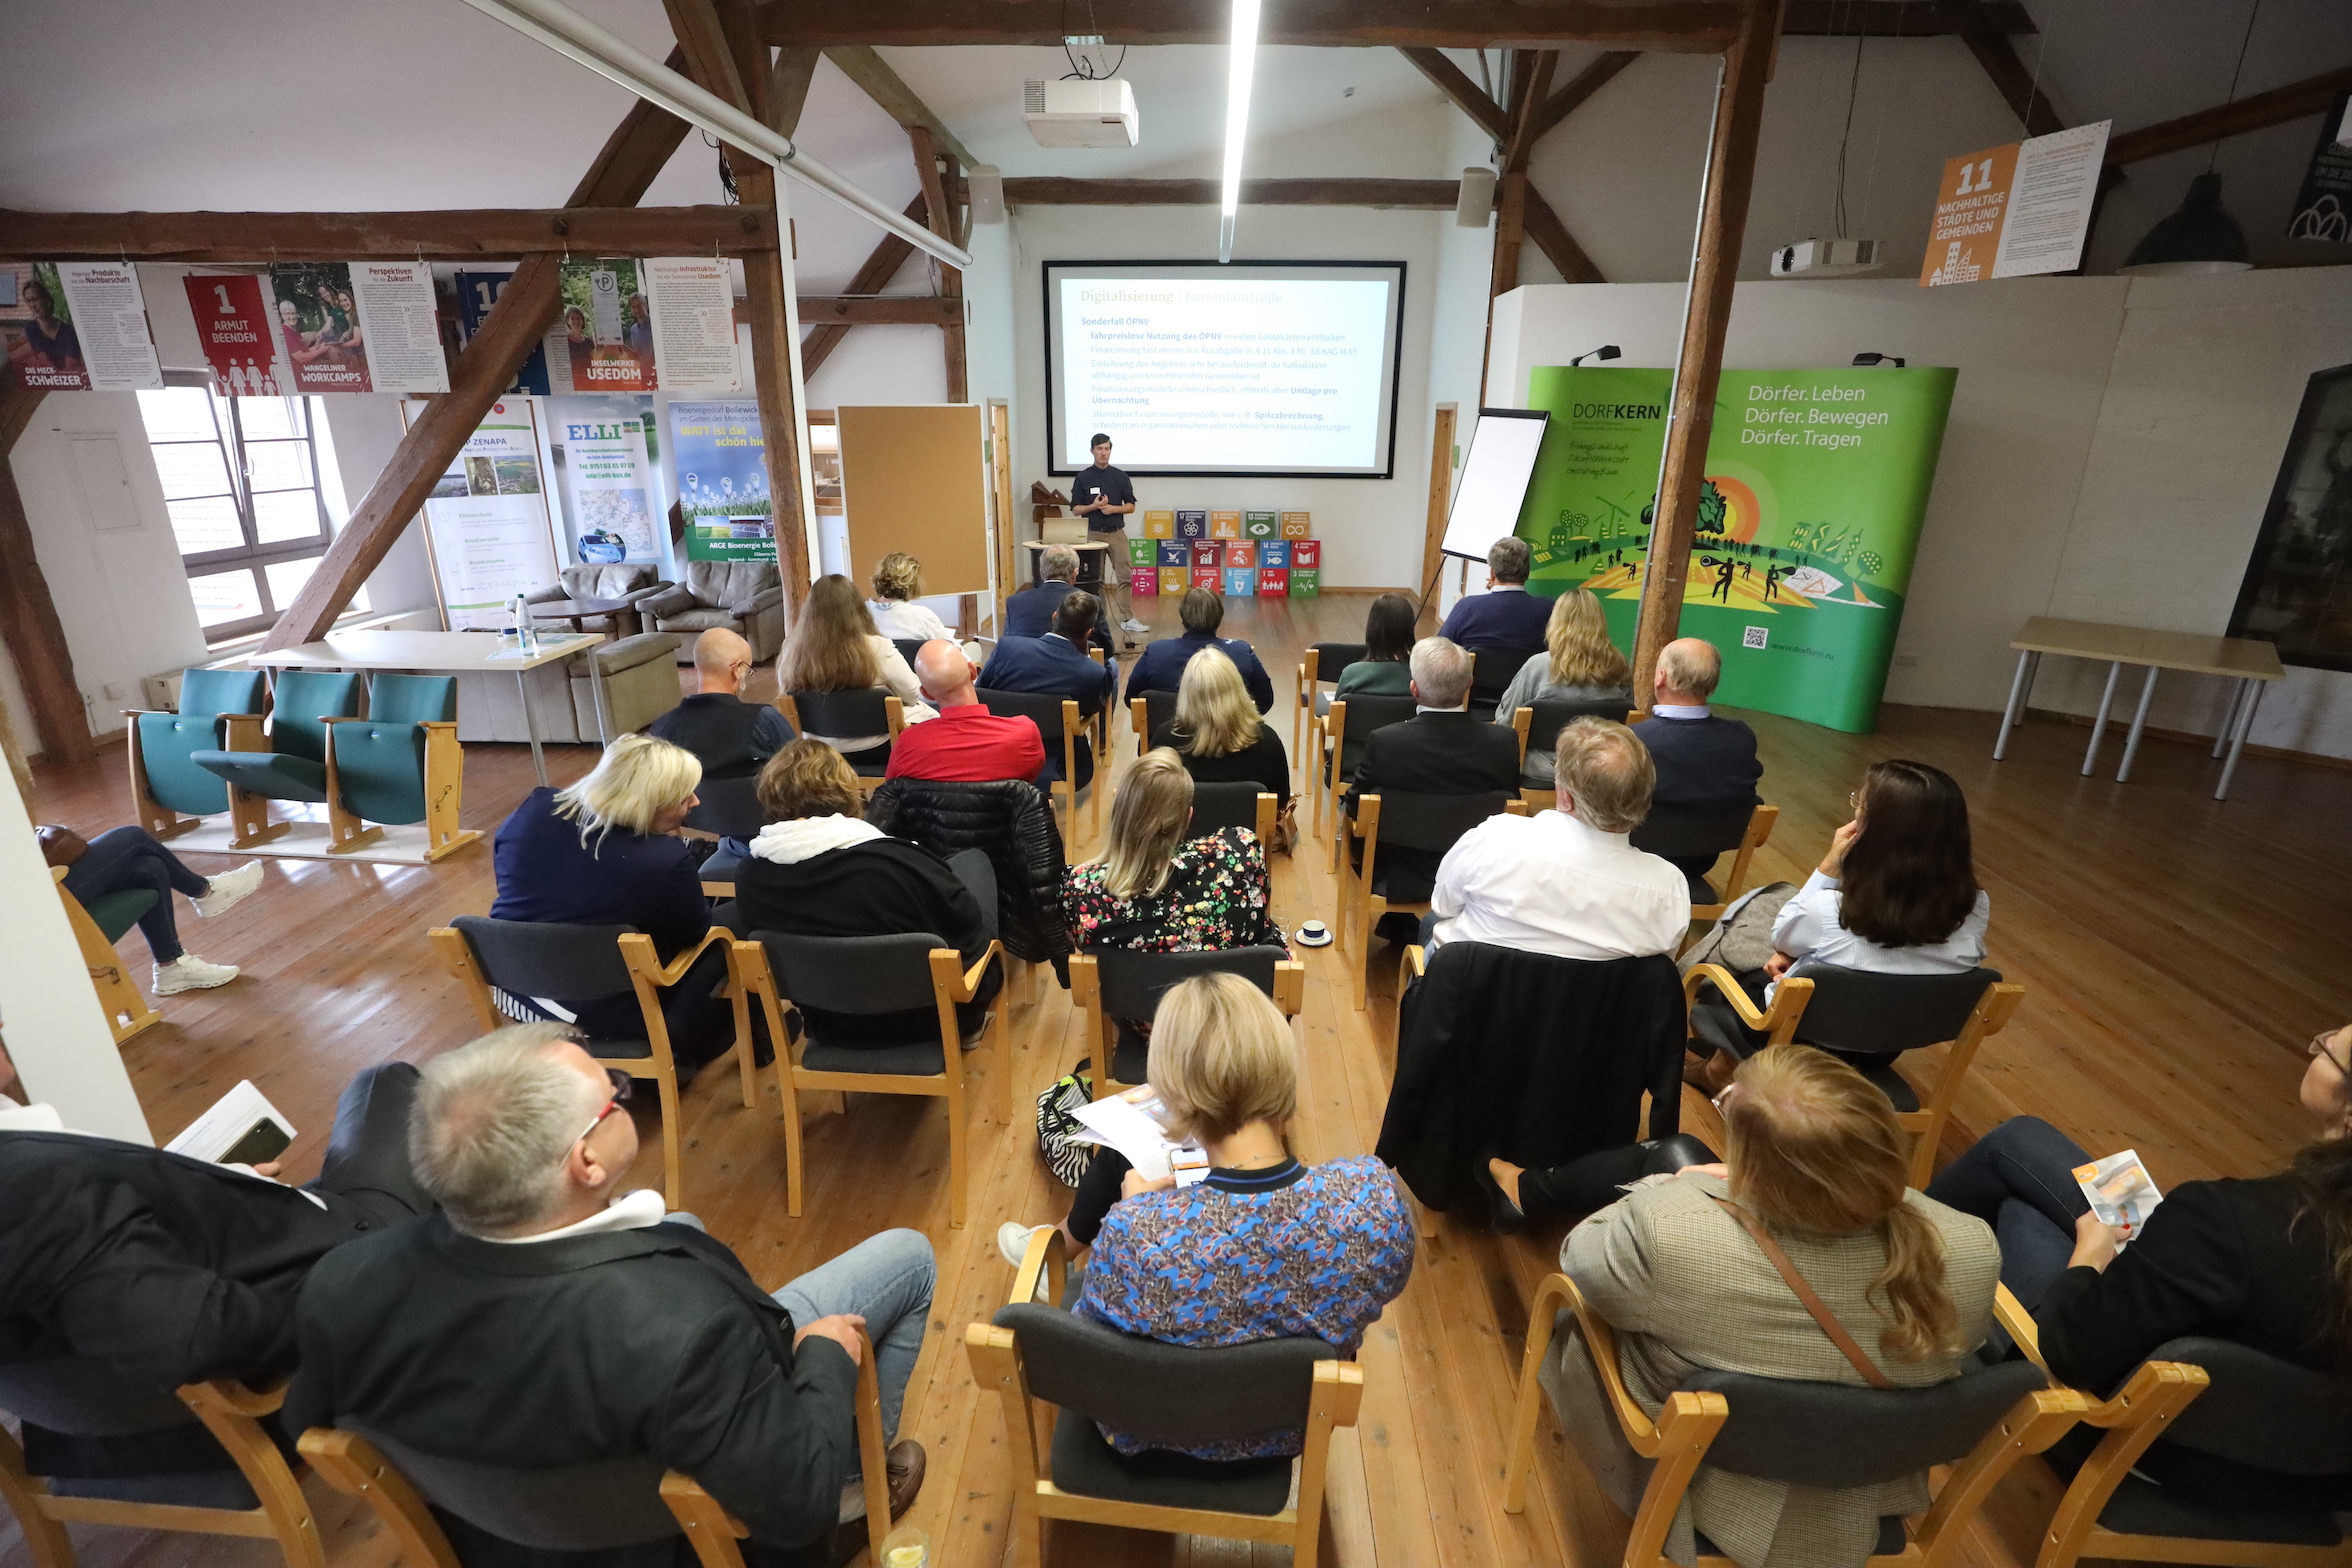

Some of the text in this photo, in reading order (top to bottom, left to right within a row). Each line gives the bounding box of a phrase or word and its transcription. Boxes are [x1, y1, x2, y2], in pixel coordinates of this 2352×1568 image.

[1956, 158, 1993, 196] 11
[1938, 191, 2005, 215] NACHHALTIGE
[1936, 206, 1999, 229] STÄDTE UND
[1936, 221, 1994, 241] GEMEINDEN
[91, 269, 121, 277] Produkte
[369, 267, 413, 277] Perspektiven
[85, 276, 131, 284] Nachbarschaft
[387, 274, 414, 283] Zukunft
[213, 284, 237, 314] 1
[1080, 289, 1283, 305] Digitalisierung Kartenkontrolle
[214, 320, 249, 332] ARMUT
[1081, 315, 1150, 326] Sonderfall ÖPNV
[211, 332, 258, 343] BEENDEN
[1090, 331, 1145, 341] fahrpreislose
[1146, 332, 1181, 342] Nutzung
[1183, 331, 1197, 340] des
[1198, 330, 1223, 340] ÖPNV
[1233, 332, 1256, 341] vielen
[1307, 333, 1346, 342] enthalten
[1090, 345, 1142, 355] Finanzierung
[1142, 345, 1157, 354] fast
[1159, 346, 1184, 354] immer
[1201, 346, 1244, 356] Kurabgabe
[1272, 347, 1288, 355] Abs.
[1310, 347, 1320, 355] 1d
[1321, 347, 1338, 356] KAG
[1339, 347, 1357, 357] M-V)
[303, 364, 347, 372] WANGELINER
[590, 359, 635, 368] INSELWERKE
[1135, 359, 1149, 368] des
[1150, 360, 1187, 370] Angebots
[1188, 360, 1205, 368] sehr
[1271, 360, 1281, 369] da
[1282, 361, 1327, 370] Kalkulation
[24, 366, 57, 375] DIE MECK-
[586, 367, 642, 381] USEDOM
[1129, 372, 1144, 380] von
[1145, 371, 1203, 380] teilnehmenden
[1204, 371, 1250, 380] Gemeinden
[1251, 372, 1261, 380] ist
[25, 374, 83, 386] SCHWEIZER
[301, 372, 362, 383] WORKCAMPS
[1091, 385, 1177, 395] Finanzierungsmodelle
[1240, 385, 1270, 394] oftmals
[1271, 386, 1289, 394] aber
[1290, 386, 1322, 396] Umlage
[1323, 388, 1338, 396] pro
[1748, 384, 1866, 402] Dörfer. Leben
[1092, 395, 1150, 406] Übernachtung
[677, 405, 758, 415] Bioenergiedorf Bollewick
[1092, 410, 1133, 418] alternative
[1134, 410, 1221, 420] Finanzierungsmodelle,
[1222, 411, 1236, 419] wie
[1573, 403, 1661, 420] DORFKERN
[688, 415, 711, 423] Garten
[711, 415, 723, 423] der
[1745, 407, 1889, 430] Dörfer. Bewegen
[566, 424, 622, 441] ELLI
[680, 425, 747, 436] WATT ist dat
[1092, 421, 1351, 433] scheitern an organisatorischen oder technischen Herausforderungen
[473, 437, 507, 446] ZENAPA
[714, 436, 747, 447] schön
[1740, 428, 1862, 450] Dörfer. Tragen
[458, 511, 493, 519] Klimaschutz
[727, 541, 761, 550] Bioenergie
[469, 558, 505, 566] Bioökonomie
[478, 579, 527, 591] ZENAPA
[1771, 643, 1835, 660] www.dorfkern.eu
